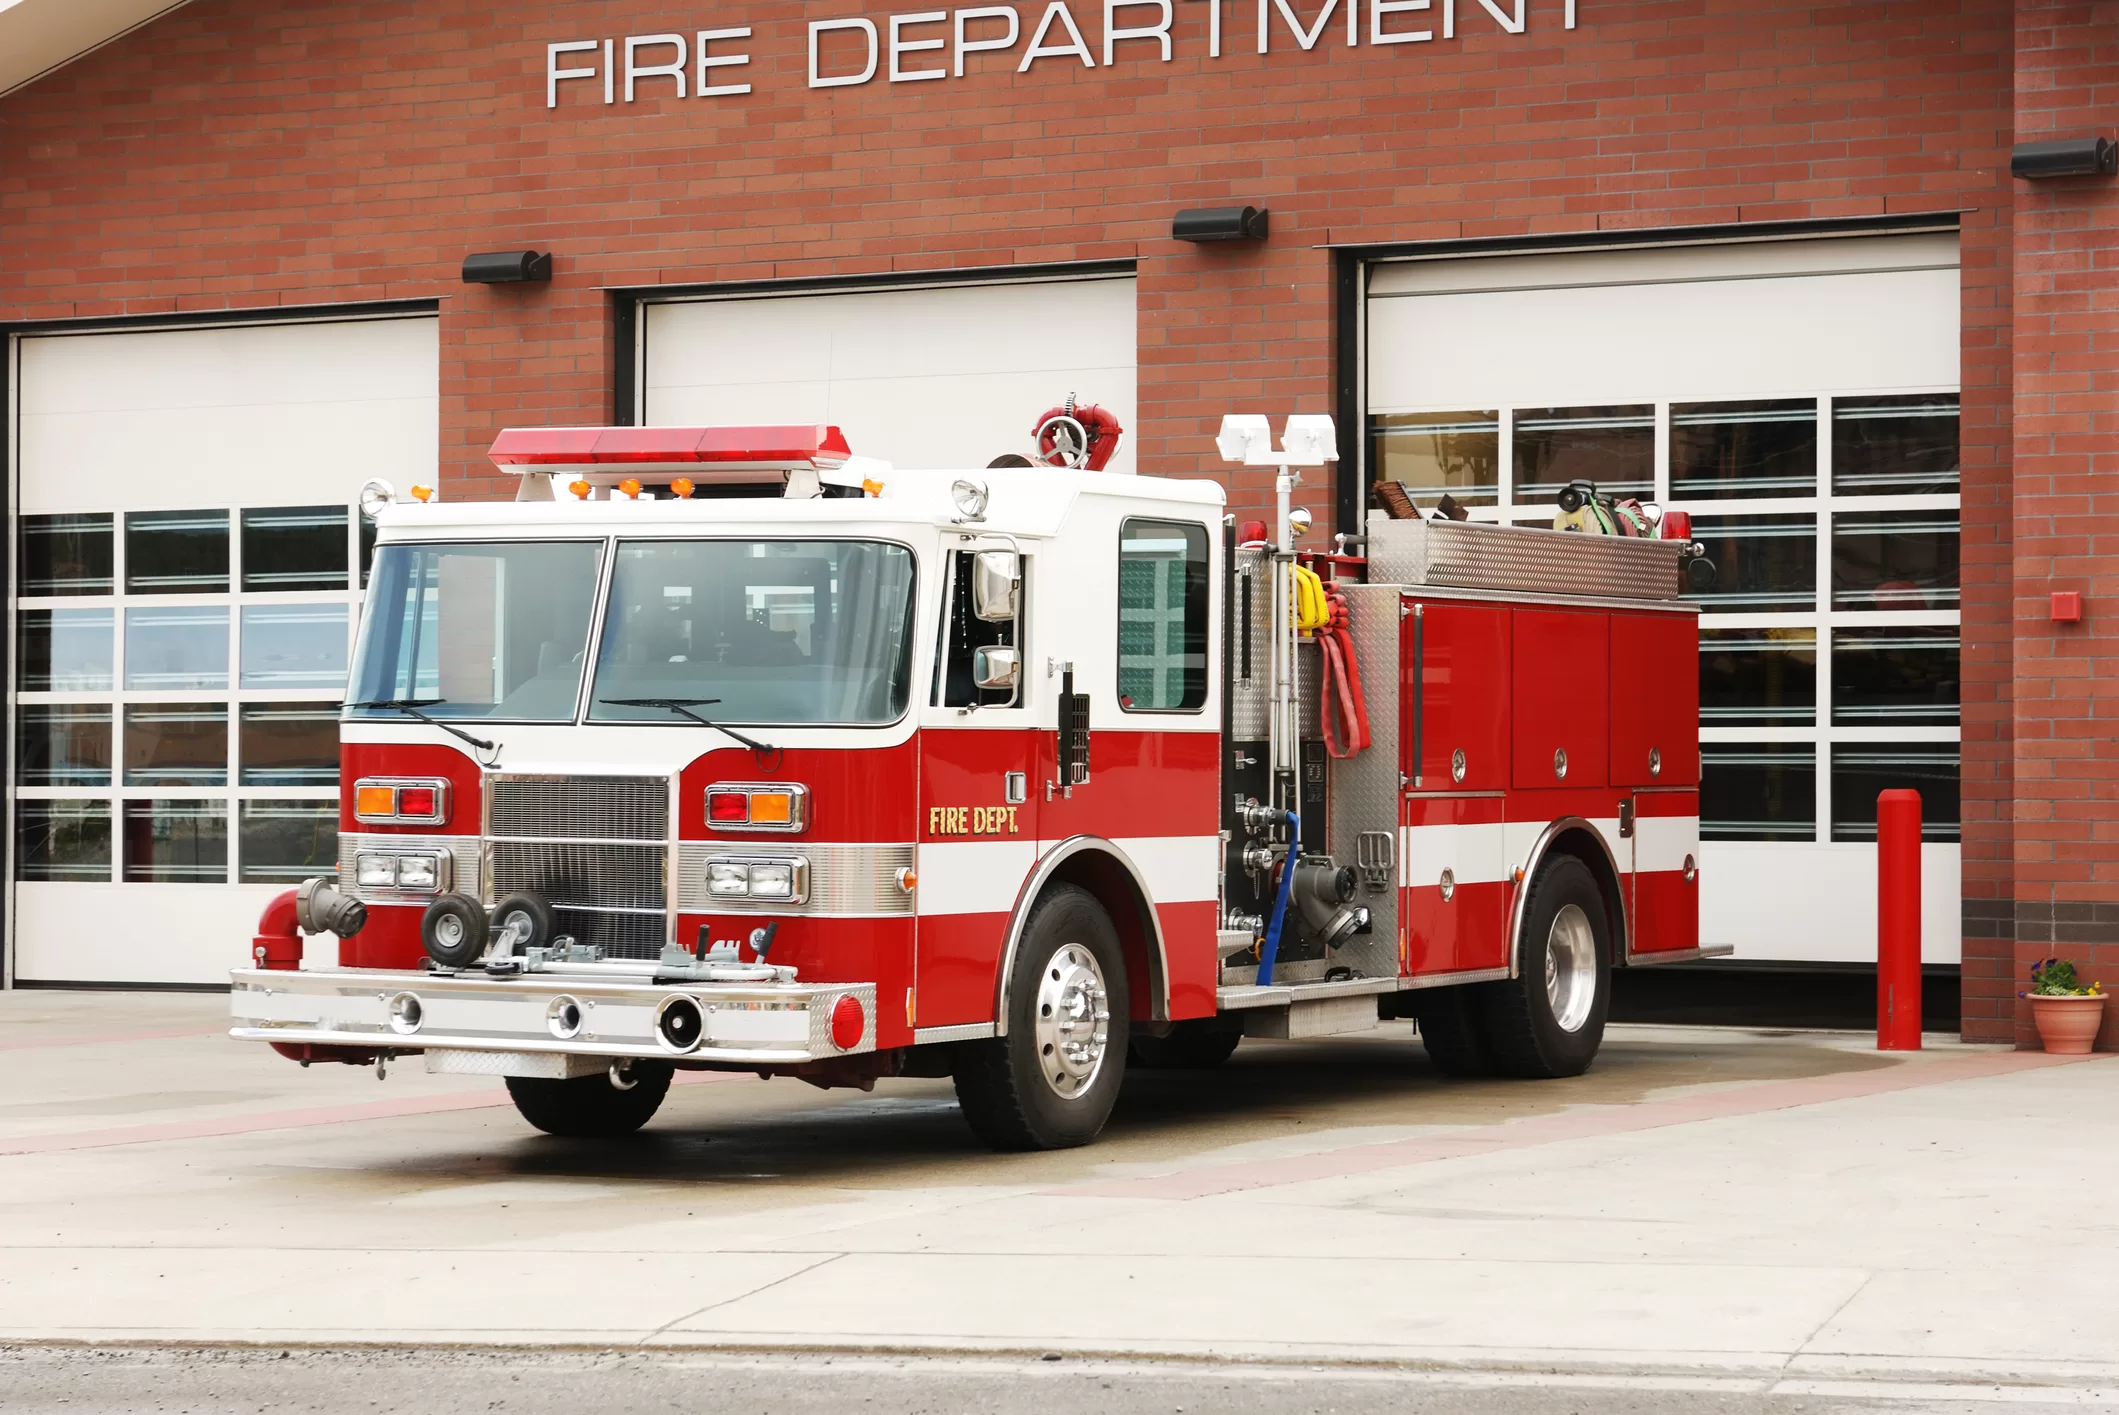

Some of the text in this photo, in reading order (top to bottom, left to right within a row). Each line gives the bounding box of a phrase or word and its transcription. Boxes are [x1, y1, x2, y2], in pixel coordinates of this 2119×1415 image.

[547, 27, 752, 108] FIRE
[929, 806, 1019, 835] FIRE DEPT.
